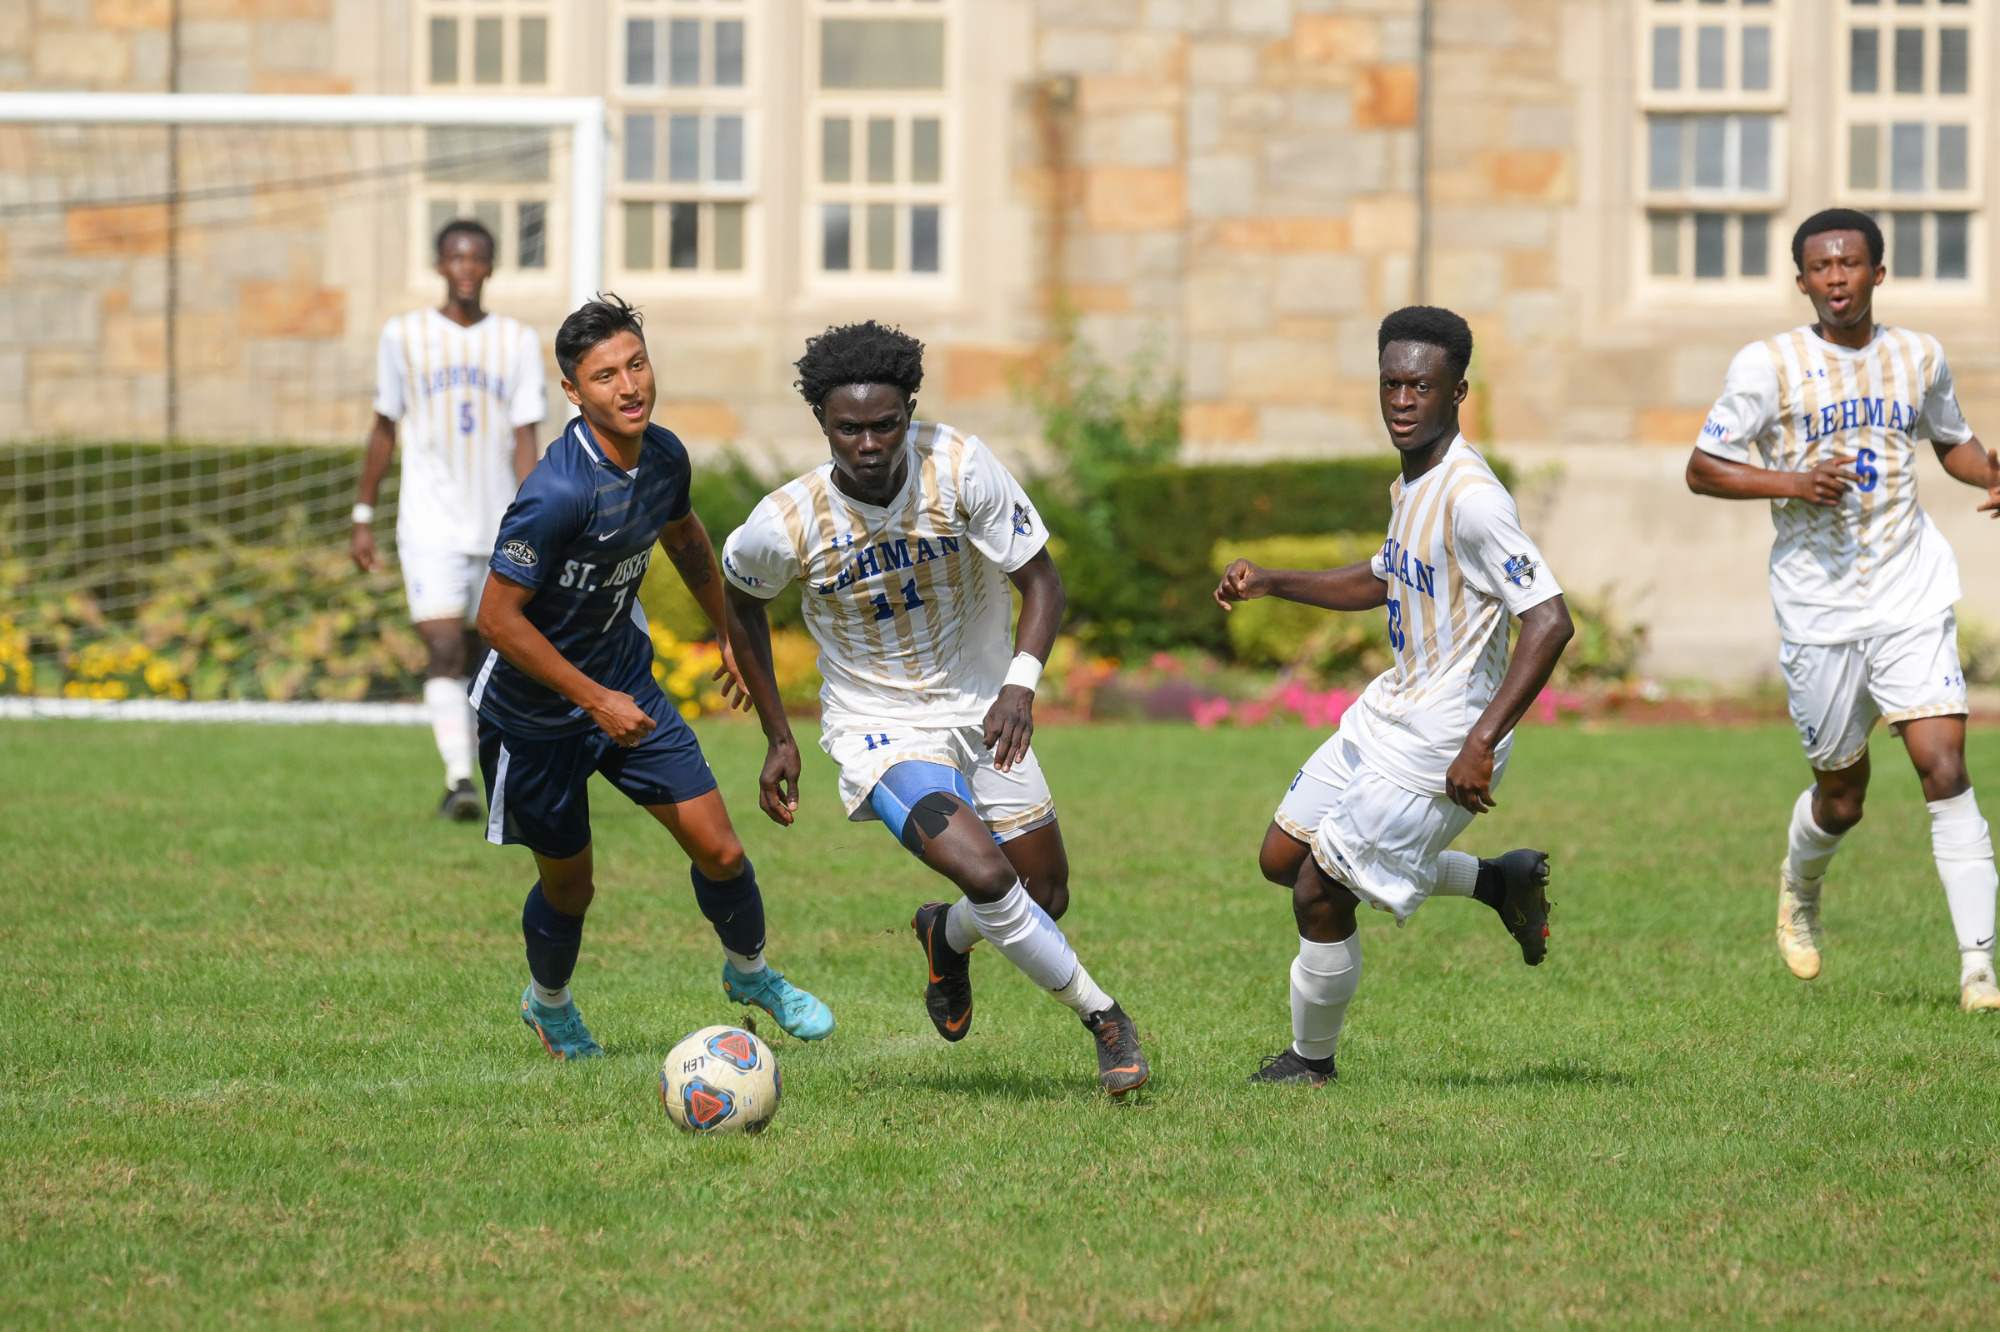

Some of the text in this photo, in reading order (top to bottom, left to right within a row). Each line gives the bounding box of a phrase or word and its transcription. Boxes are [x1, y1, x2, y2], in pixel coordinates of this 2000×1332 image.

[459, 402, 475, 436] 5
[1803, 397, 1919, 442] LEHMAN
[1855, 448, 1878, 492] 6
[558, 559, 597, 592] ST.
[601, 586, 629, 634] 7
[869, 578, 925, 621] 11
[864, 733, 891, 751] 11
[683, 1055, 705, 1074] LEH
